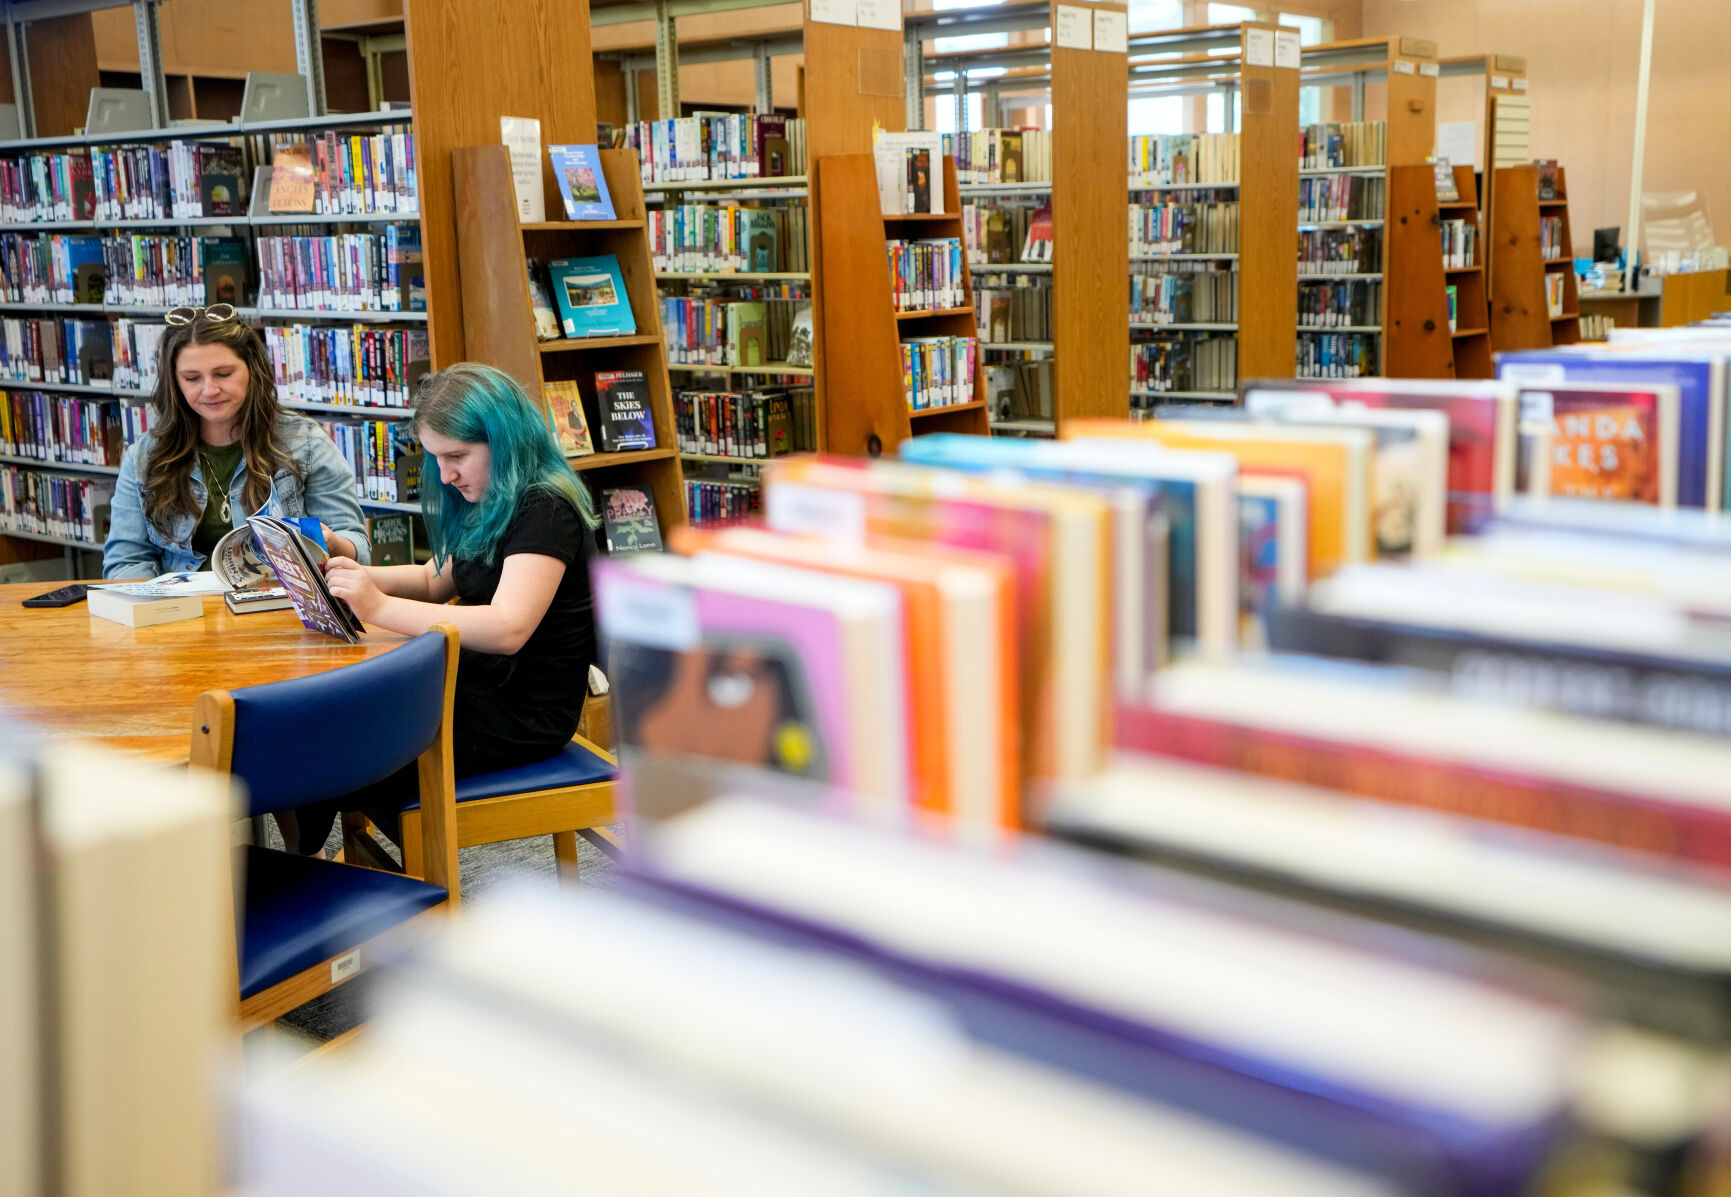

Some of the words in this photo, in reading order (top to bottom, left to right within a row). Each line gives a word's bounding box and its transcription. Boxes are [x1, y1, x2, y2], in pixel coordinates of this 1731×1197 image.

[616, 391, 635, 400] THE
[610, 410, 646, 421] BELOW
[606, 504, 654, 521] PRETTY
[376, 517, 404, 529] CAROL
[615, 544, 638, 552] Nancy
